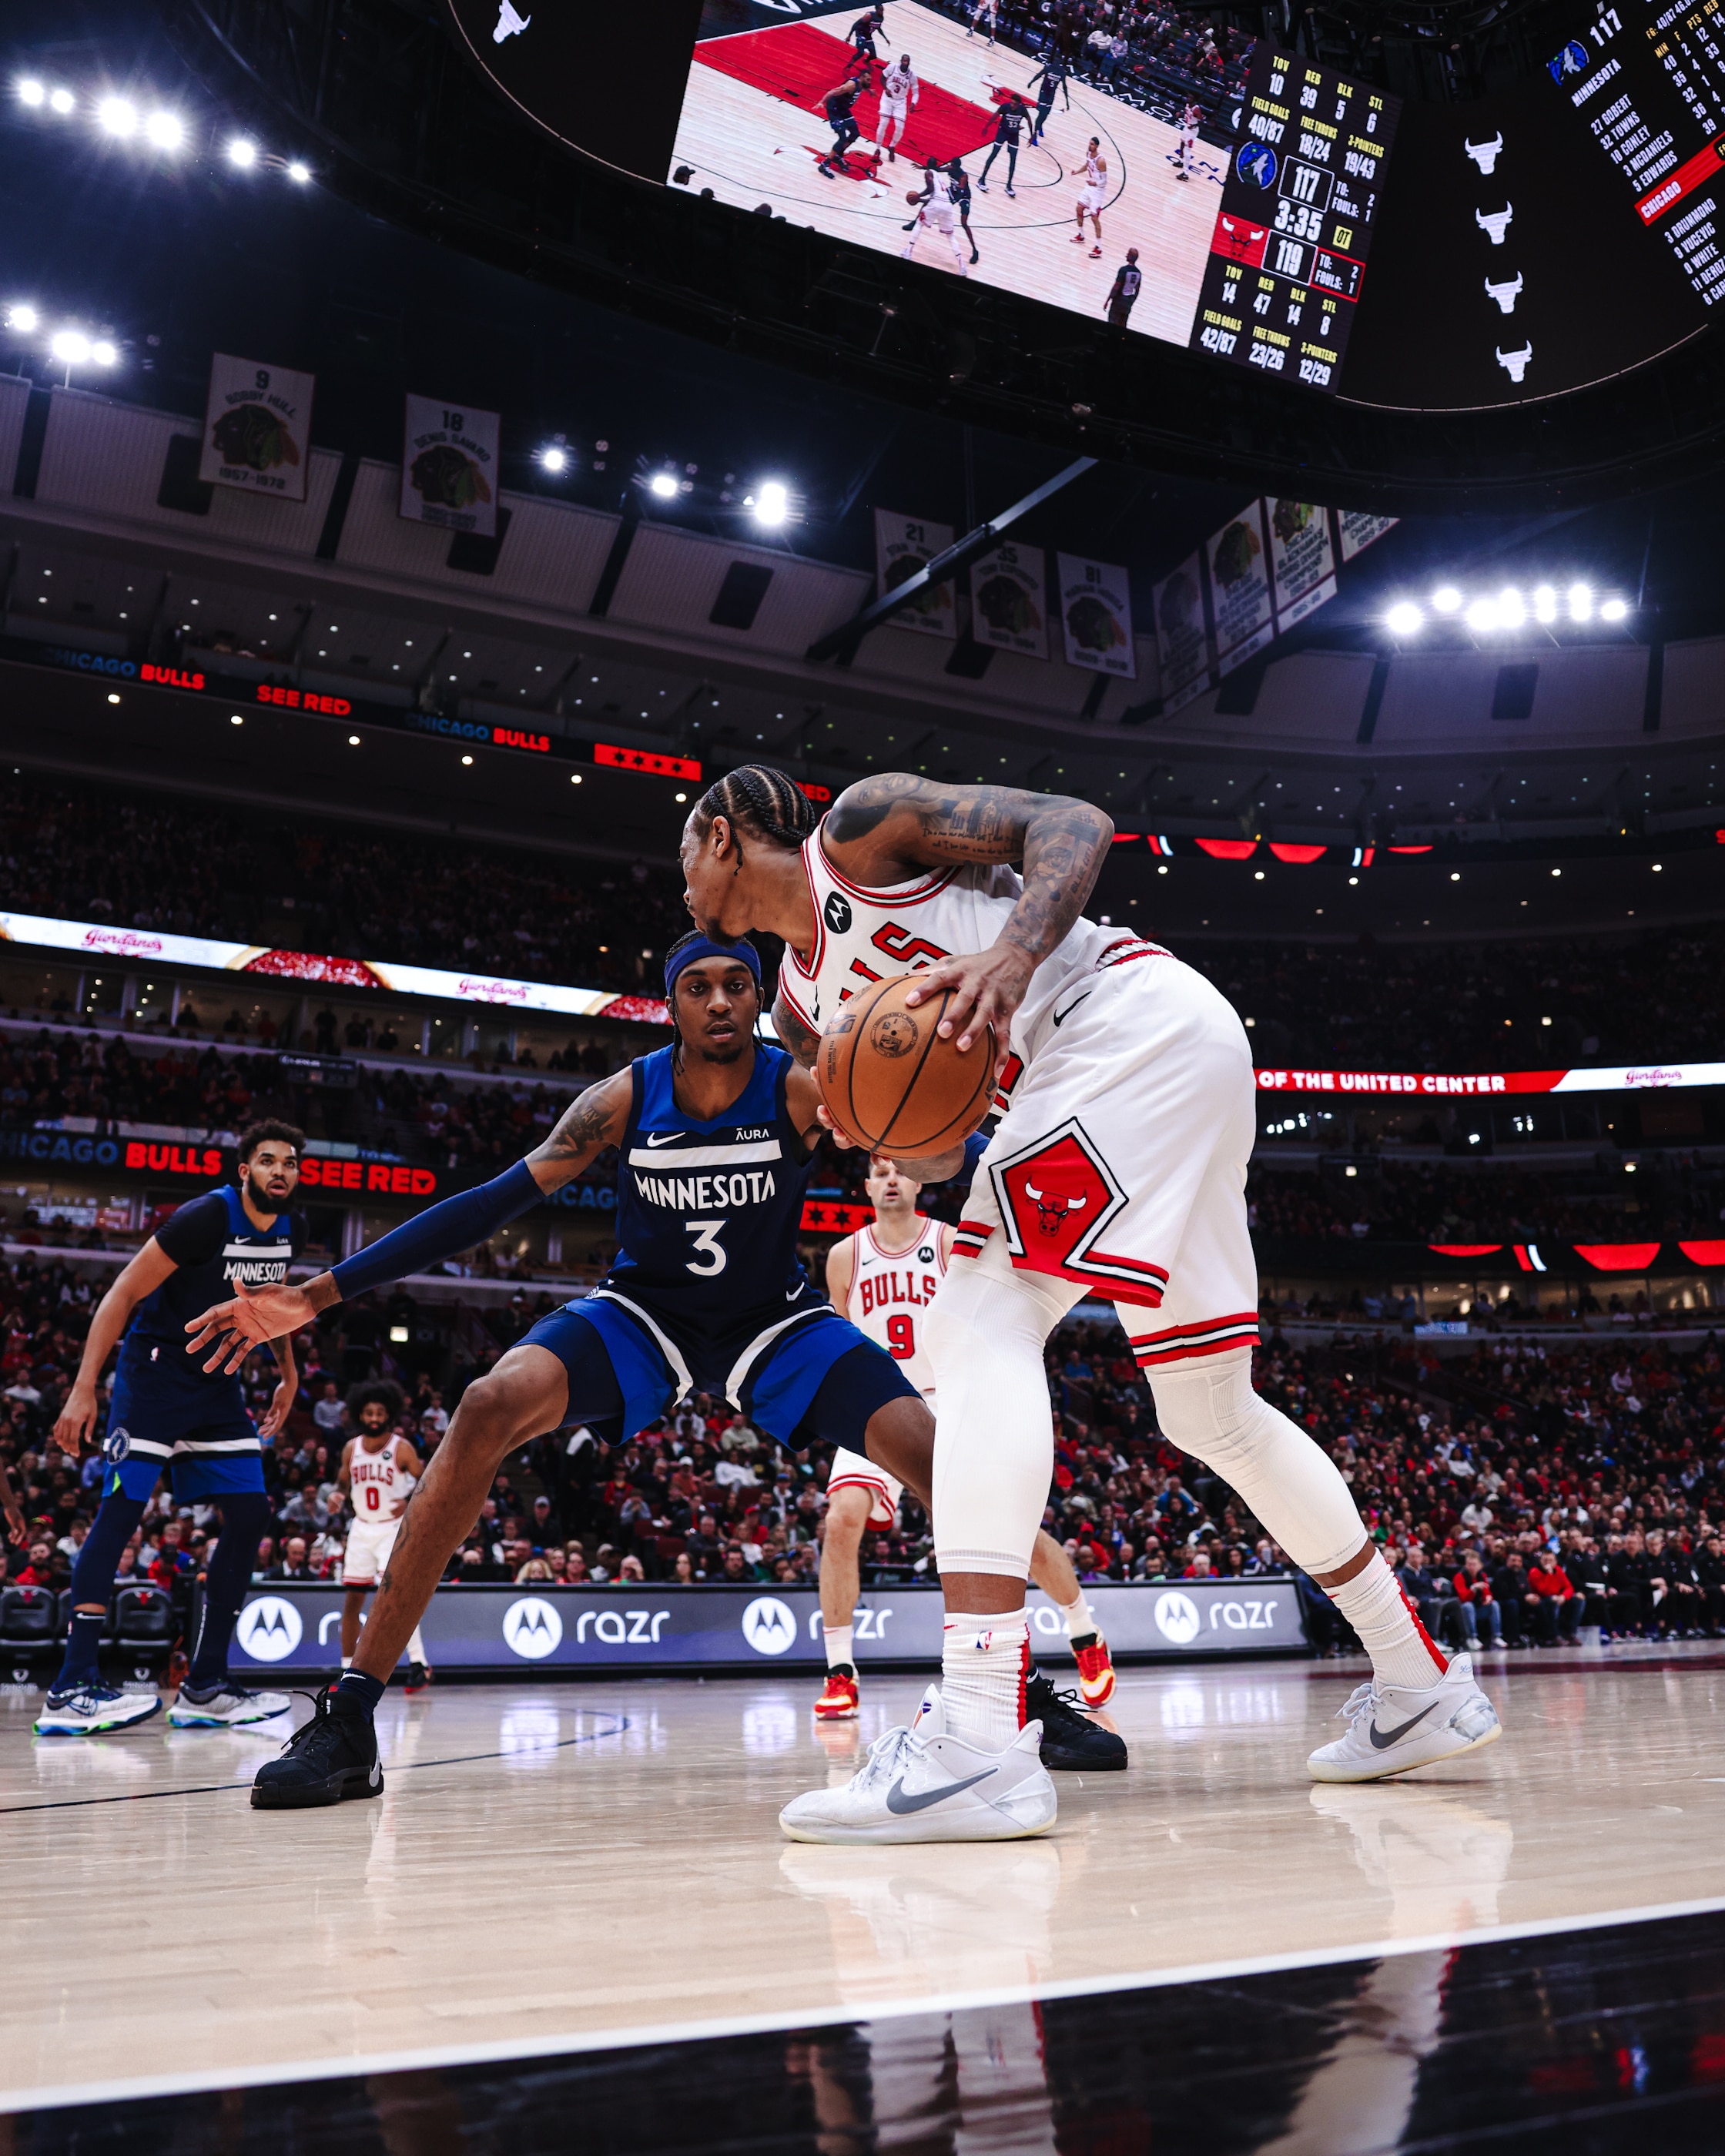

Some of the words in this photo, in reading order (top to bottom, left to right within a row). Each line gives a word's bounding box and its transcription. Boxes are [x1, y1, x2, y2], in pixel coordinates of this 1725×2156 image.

[1590, 8, 1622, 46] 117
[1646, 28, 1658, 39] FG:
[1656, 8, 1676, 29] 40/87
[1655, 42, 1669, 58] MIN
[1674, 32, 1680, 40] F
[1687, 14, 1702, 29] PTS
[1703, 0, 1718, 15] REB
[1273, 56, 1289, 72] TOV
[1305, 69, 1321, 85] REB
[1337, 82, 1353, 98] BLK
[1368, 95, 1382, 110] STL
[1572, 59, 1621, 107] MINNESOTA
[1591, 119, 1603, 135] 27
[1602, 94, 1632, 126] GOBERT
[1664, 55, 1676, 70] 40
[1681, 43, 1691, 55] 2
[1696, 27, 1709, 42] 12
[1712, 12, 1725, 28] 14
[1269, 73, 1284, 95] 10
[1300, 85, 1318, 109] 39
[1335, 100, 1346, 120] 5
[1367, 113, 1377, 132] 6
[1600, 135, 1613, 149] 32
[1610, 111, 1640, 139] TOWNS
[1673, 71, 1686, 87] 35
[1692, 59, 1700, 70] 4
[1705, 42, 1720, 59] 33
[1251, 96, 1270, 113] FIELD
[1269, 103, 1290, 120] GOALS
[1301, 116, 1315, 130] FREE
[1315, 121, 1338, 139] THROWS
[1348, 135, 1384, 157] 3-POINTERS
[1611, 149, 1623, 164] 10
[1620, 125, 1650, 156] CONLEY
[1683, 87, 1697, 102] 32
[1702, 75, 1710, 86] 1
[1623, 165, 1632, 176] 3
[1629, 130, 1673, 171] MCDANIELS
[1693, 102, 1707, 119] 36
[1712, 91, 1720, 102] 4
[1248, 114, 1285, 143] 40/87
[1299, 133, 1331, 162] 18/24
[1345, 151, 1375, 179] 19/43
[1633, 179, 1642, 192] 5
[1640, 150, 1677, 183] EDWARDS
[1703, 119, 1717, 135] 39
[1292, 166, 1320, 202] 117
[1336, 181, 1349, 196] TO:
[1368, 194, 1375, 206] 2
[1641, 181, 1681, 218] CHICAGO
[1274, 200, 1323, 242] 3:35
[1331, 196, 1358, 217] FOULS:
[1365, 209, 1371, 222] 1
[1664, 232, 1673, 243] 3
[1671, 198, 1717, 238] DRUMMOND
[1338, 229, 1350, 245] OT
[1674, 246, 1683, 259] 9
[1680, 222, 1716, 253] VUCEVIC
[1690, 243, 1719, 269] WHITE
[1275, 239, 1303, 276] 119
[1319, 254, 1332, 270] TO:
[1352, 266, 1358, 279] 2
[1226, 265, 1242, 280] TOV
[1258, 276, 1274, 291] REB
[1290, 288, 1306, 302] BLK
[1322, 299, 1336, 313] STL
[1315, 270, 1342, 290] FOULS:
[1349, 282, 1354, 293] 1
[1691, 277, 1703, 290] 11
[1703, 293, 1712, 305] 6
[1710, 279, 1725, 300] CAR
[1222, 282, 1237, 303] 14
[1253, 293, 1271, 314] 47
[1287, 304, 1301, 325] 14
[1320, 316, 1331, 335] 8
[1201, 326, 1237, 354] 42/87
[1249, 343, 1285, 370] 23/26
[1299, 359, 1331, 385] 12/29
[1204, 310, 1221, 324] FIELD
[1221, 316, 1241, 331] GOALS
[1253, 326, 1268, 340] FREE
[1267, 330, 1291, 347] THROWS
[1301, 342, 1337, 363] 3-POINTERS
[256, 370, 270, 389] 9
[267, 394, 296, 419] HULL
[443, 410, 464, 431] 18
[906, 524, 924, 542] 21
[1085, 566, 1101, 584] 81
[141, 664, 205, 690] BULLS
[257, 685, 299, 707] SEE
[303, 689, 350, 715] RED
[405, 712, 489, 740] CHICAGO
[494, 727, 549, 752] BULLS
[1259, 1071, 1287, 1088] OF
[1291, 1072, 1335, 1090] THE
[1340, 1074, 1416, 1092] UNITED
[1422, 1076, 1506, 1093] CENTER
[0, 1130, 119, 1166] HICAGO
[125, 1142, 222, 1176] BULLS
[300, 1158, 361, 1190] SEE
[367, 1165, 436, 1194] RED
[634, 1170, 775, 1210] MINNESOTA
[685, 1220, 728, 1277] 3
[860, 1271, 936, 1317] BULLS
[887, 1314, 915, 1359] 9
[351, 1464, 394, 1486] BULLS
[367, 1487, 379, 1510] 0
[576, 1610, 671, 1644] razr
[809, 1609, 893, 1640] rzr
[1209, 1600, 1278, 1630] razr
